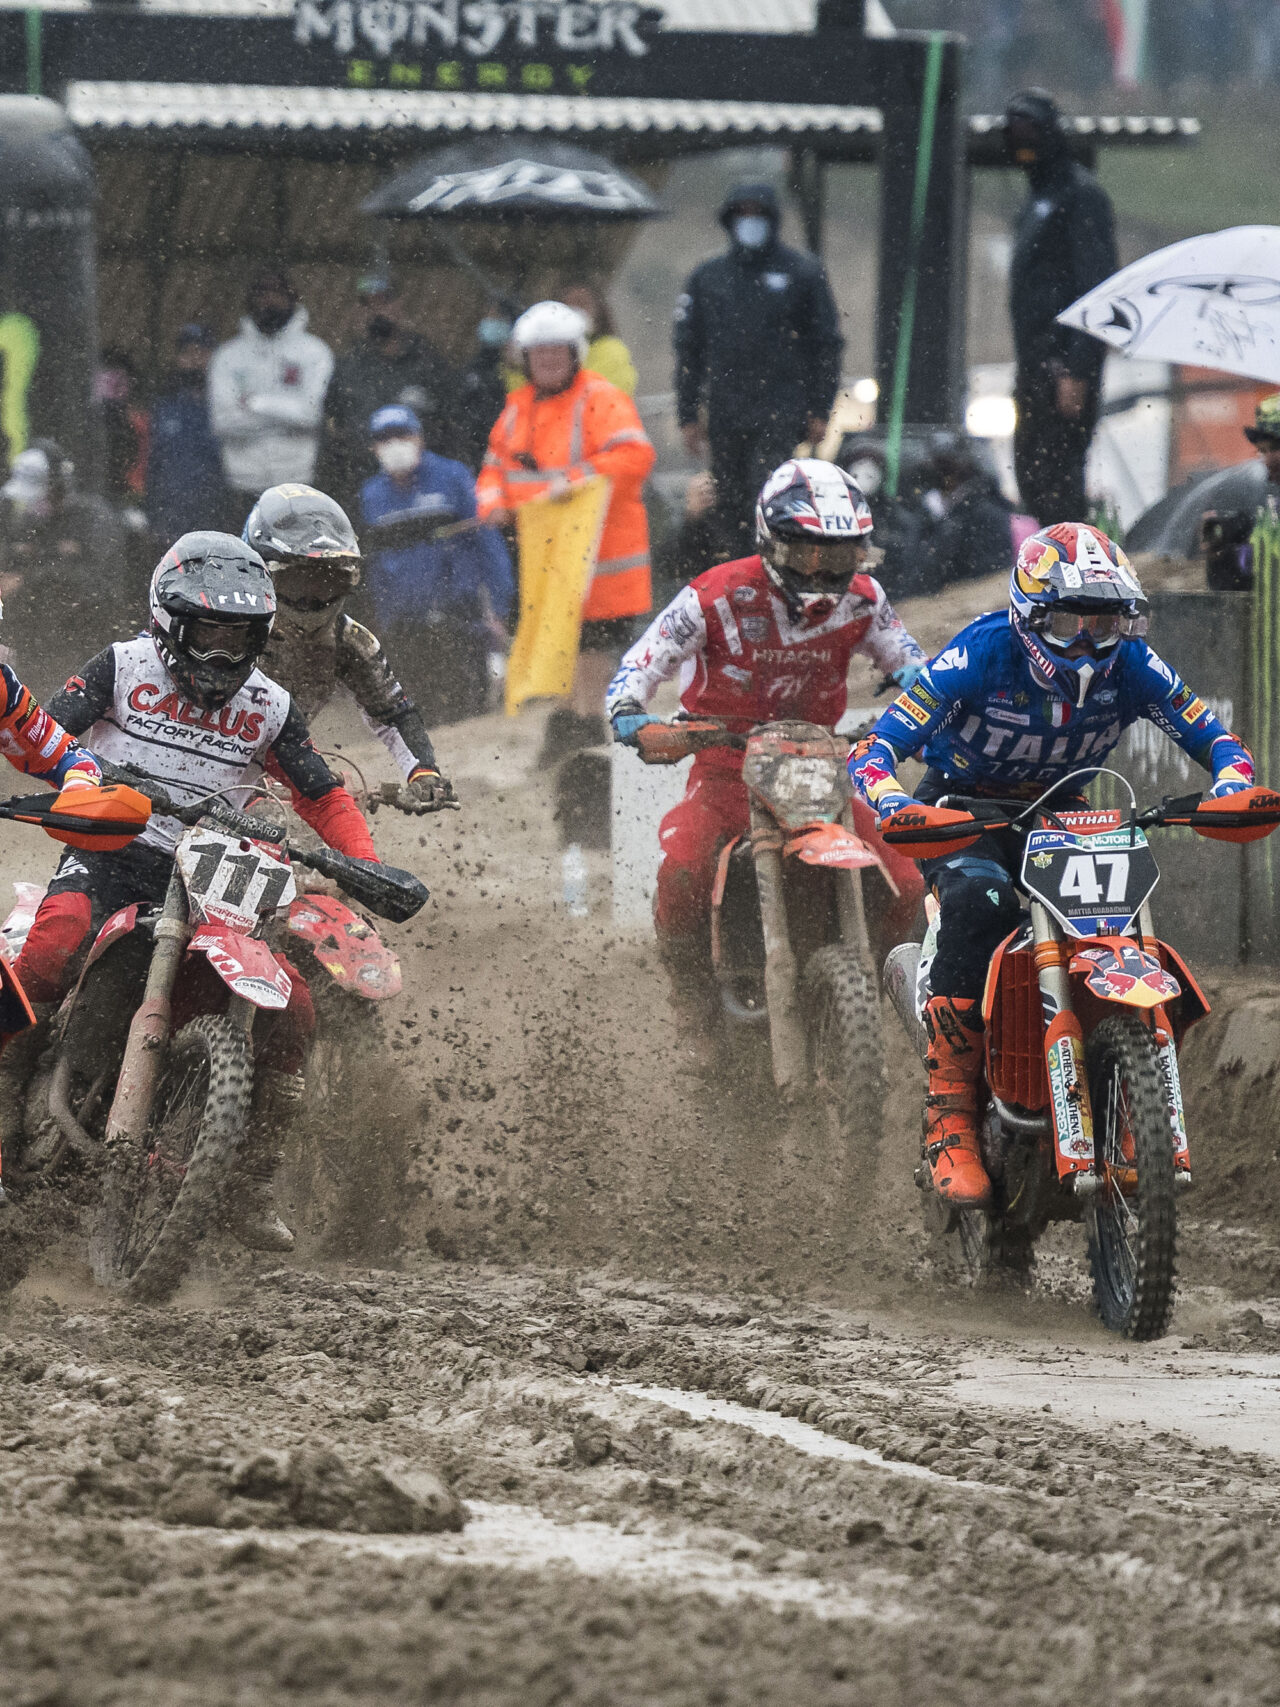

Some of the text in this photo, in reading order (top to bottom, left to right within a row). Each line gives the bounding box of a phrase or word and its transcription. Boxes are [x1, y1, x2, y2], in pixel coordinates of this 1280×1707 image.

[295, 0, 650, 55] MONSTER
[347, 60, 593, 93] ENERGY
[825, 515, 853, 531] FLY
[156, 638, 178, 668] FLY
[753, 649, 831, 665] HITACHI
[129, 683, 266, 743] CALLUS
[898, 694, 928, 722] PIRELLI
[127, 713, 257, 757] FACTORY RACING
[959, 714, 1120, 764] ITALIA
[881, 801, 900, 810] THOR
[889, 813, 927, 827] KTM
[189, 842, 291, 914] 111
[1059, 853, 1131, 904] 47
[204, 904, 255, 927] CANADA
[1068, 907, 1092, 917] MATTIA
[1062, 1046, 1074, 1083] ATHENA
[1050, 1069, 1071, 1141] MOTOREX
[1068, 1100, 1081, 1136] ATHENA
